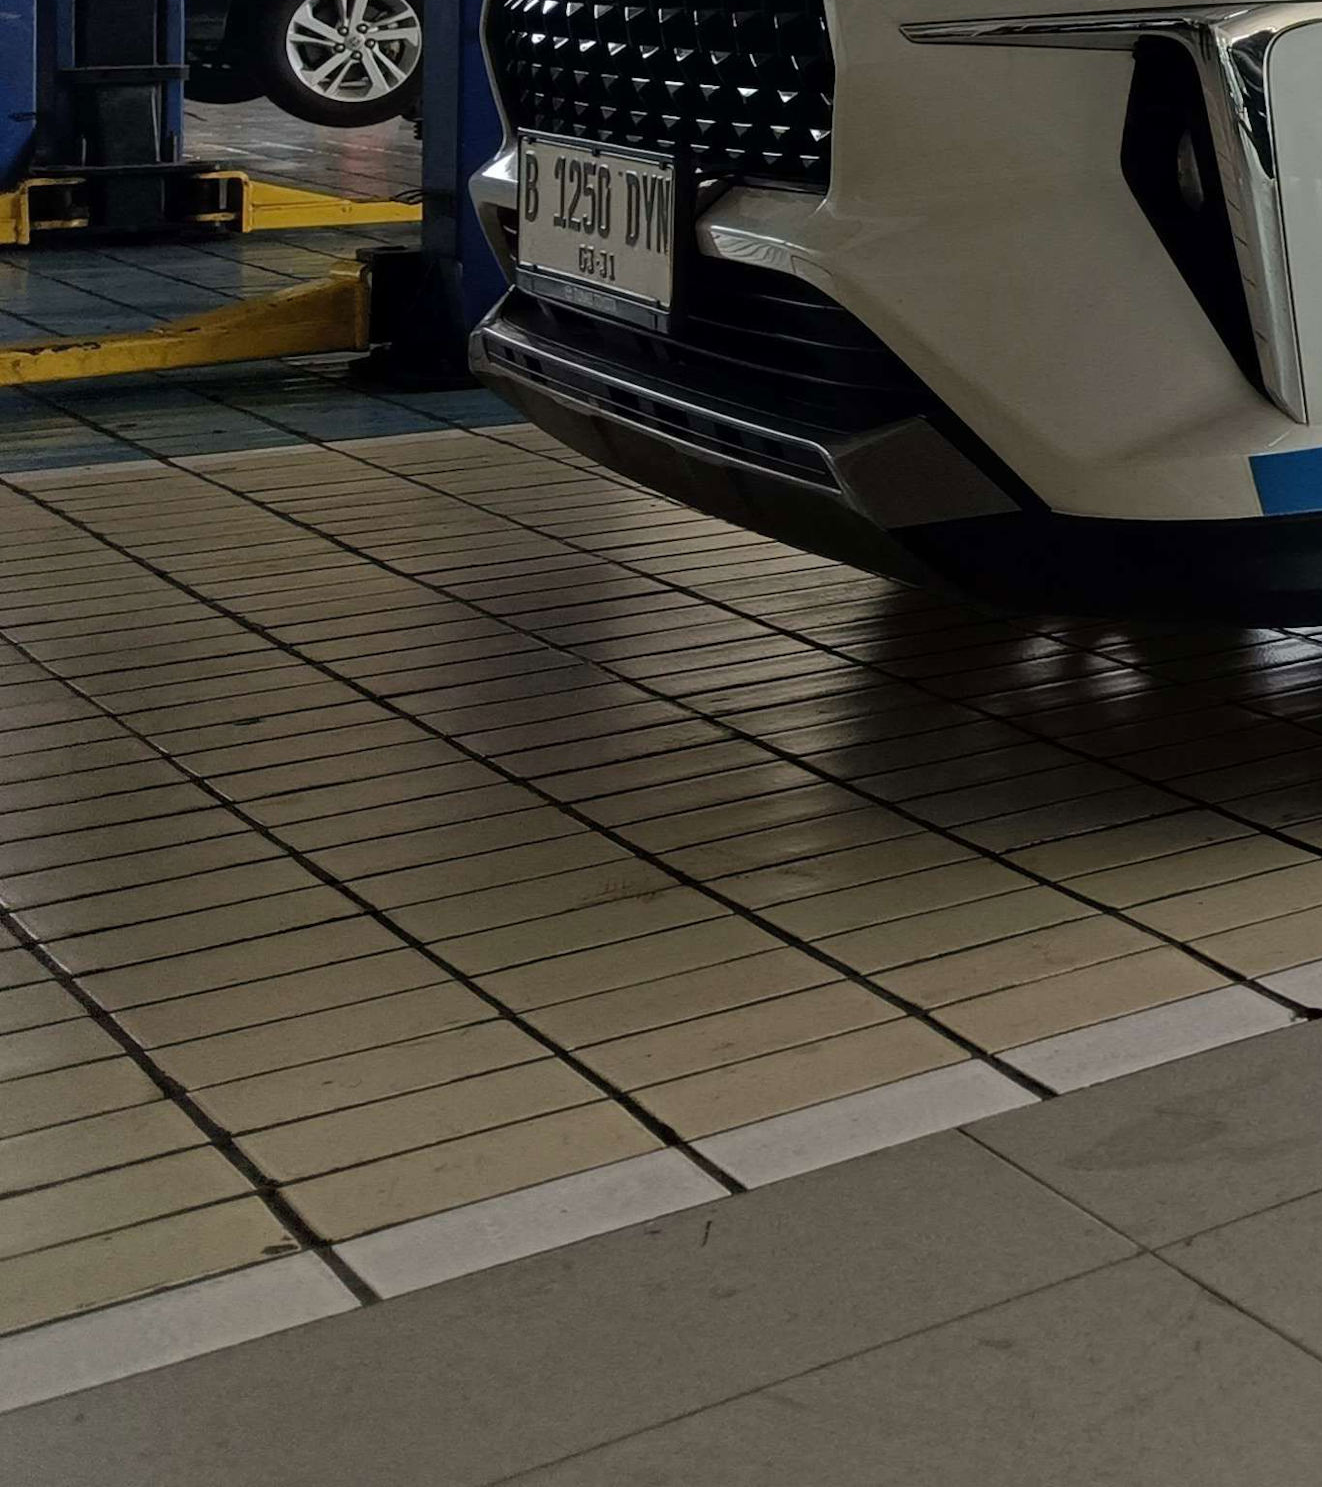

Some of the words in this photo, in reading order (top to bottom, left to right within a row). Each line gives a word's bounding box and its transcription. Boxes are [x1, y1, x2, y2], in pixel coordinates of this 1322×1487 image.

[525, 150, 538, 222] B
[553, 156, 611, 238] 1250
[625, 170, 670, 255] DYN
